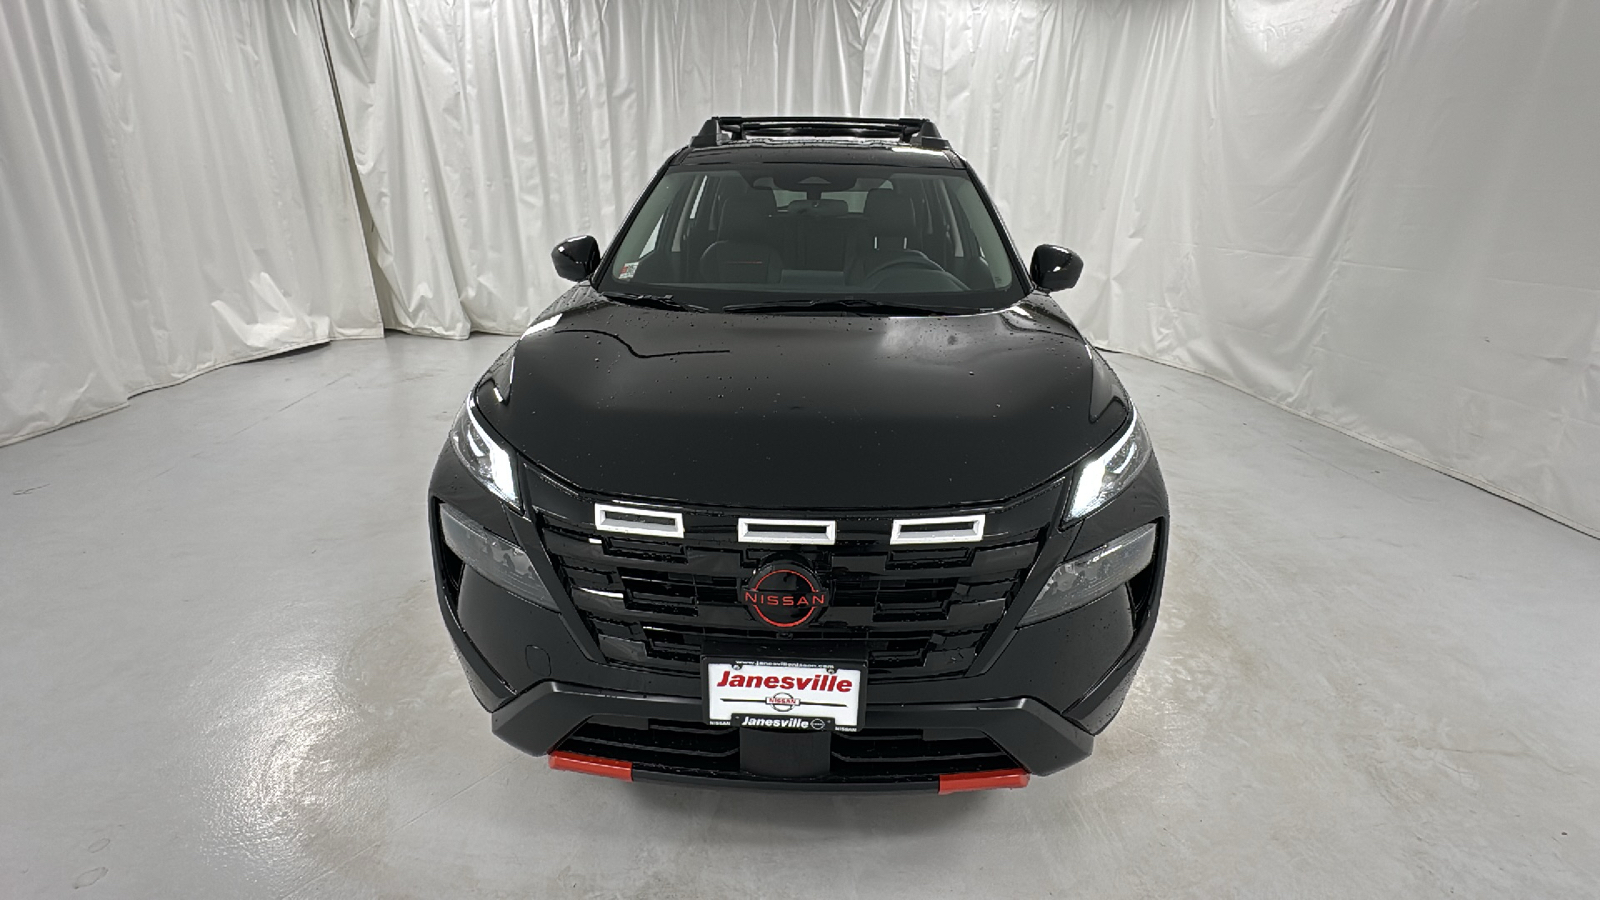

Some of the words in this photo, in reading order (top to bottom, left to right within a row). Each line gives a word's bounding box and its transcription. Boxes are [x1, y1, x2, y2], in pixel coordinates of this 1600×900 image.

[744, 591, 825, 606] NISSAN
[717, 671, 853, 693] Janesville
[741, 716, 809, 729] Janesville
